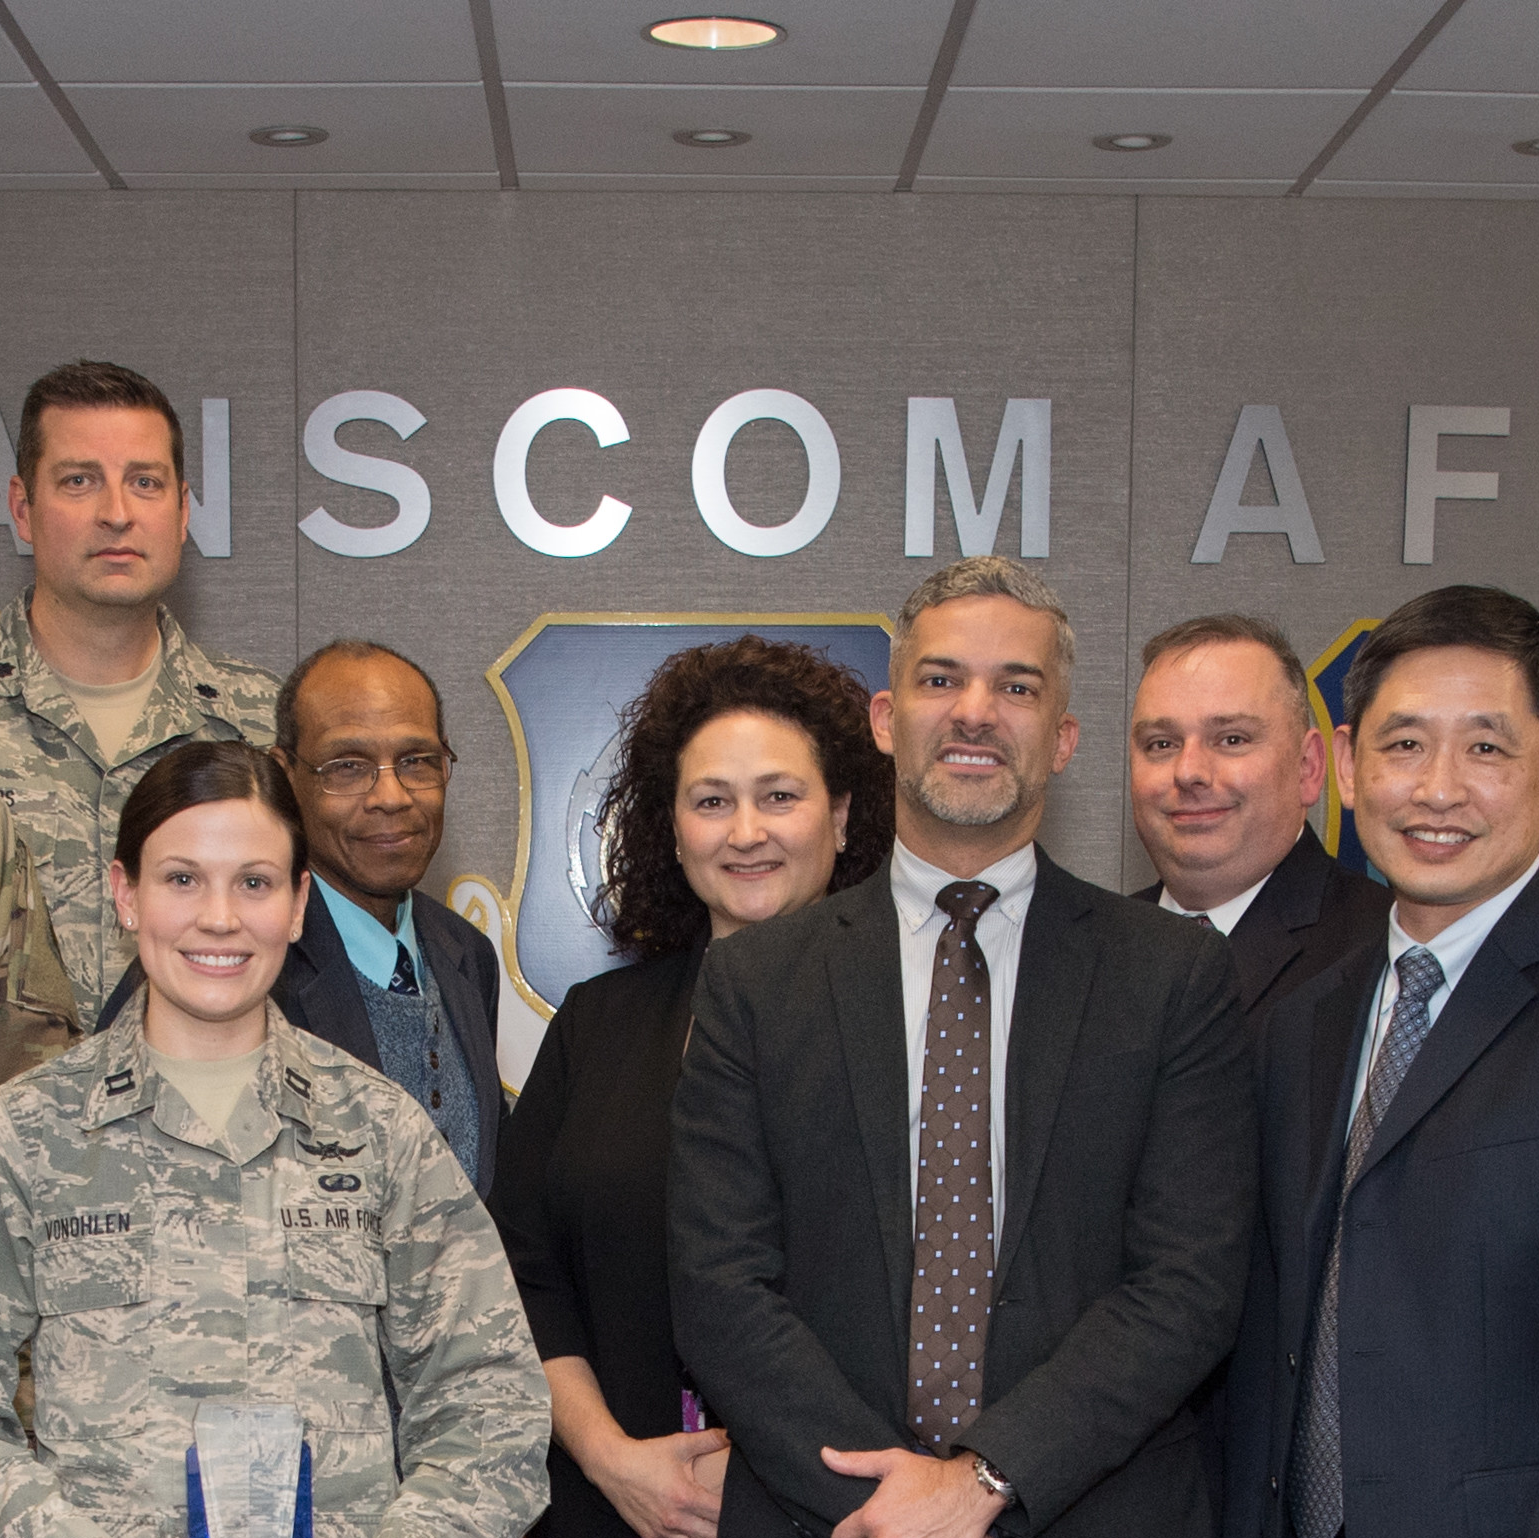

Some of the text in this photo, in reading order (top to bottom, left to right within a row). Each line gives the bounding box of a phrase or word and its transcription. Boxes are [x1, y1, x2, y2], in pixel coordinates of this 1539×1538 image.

[44, 1212, 130, 1241] VONOHLEN
[280, 1208, 319, 1228] U.S.
[325, 1208, 351, 1229] AIR
